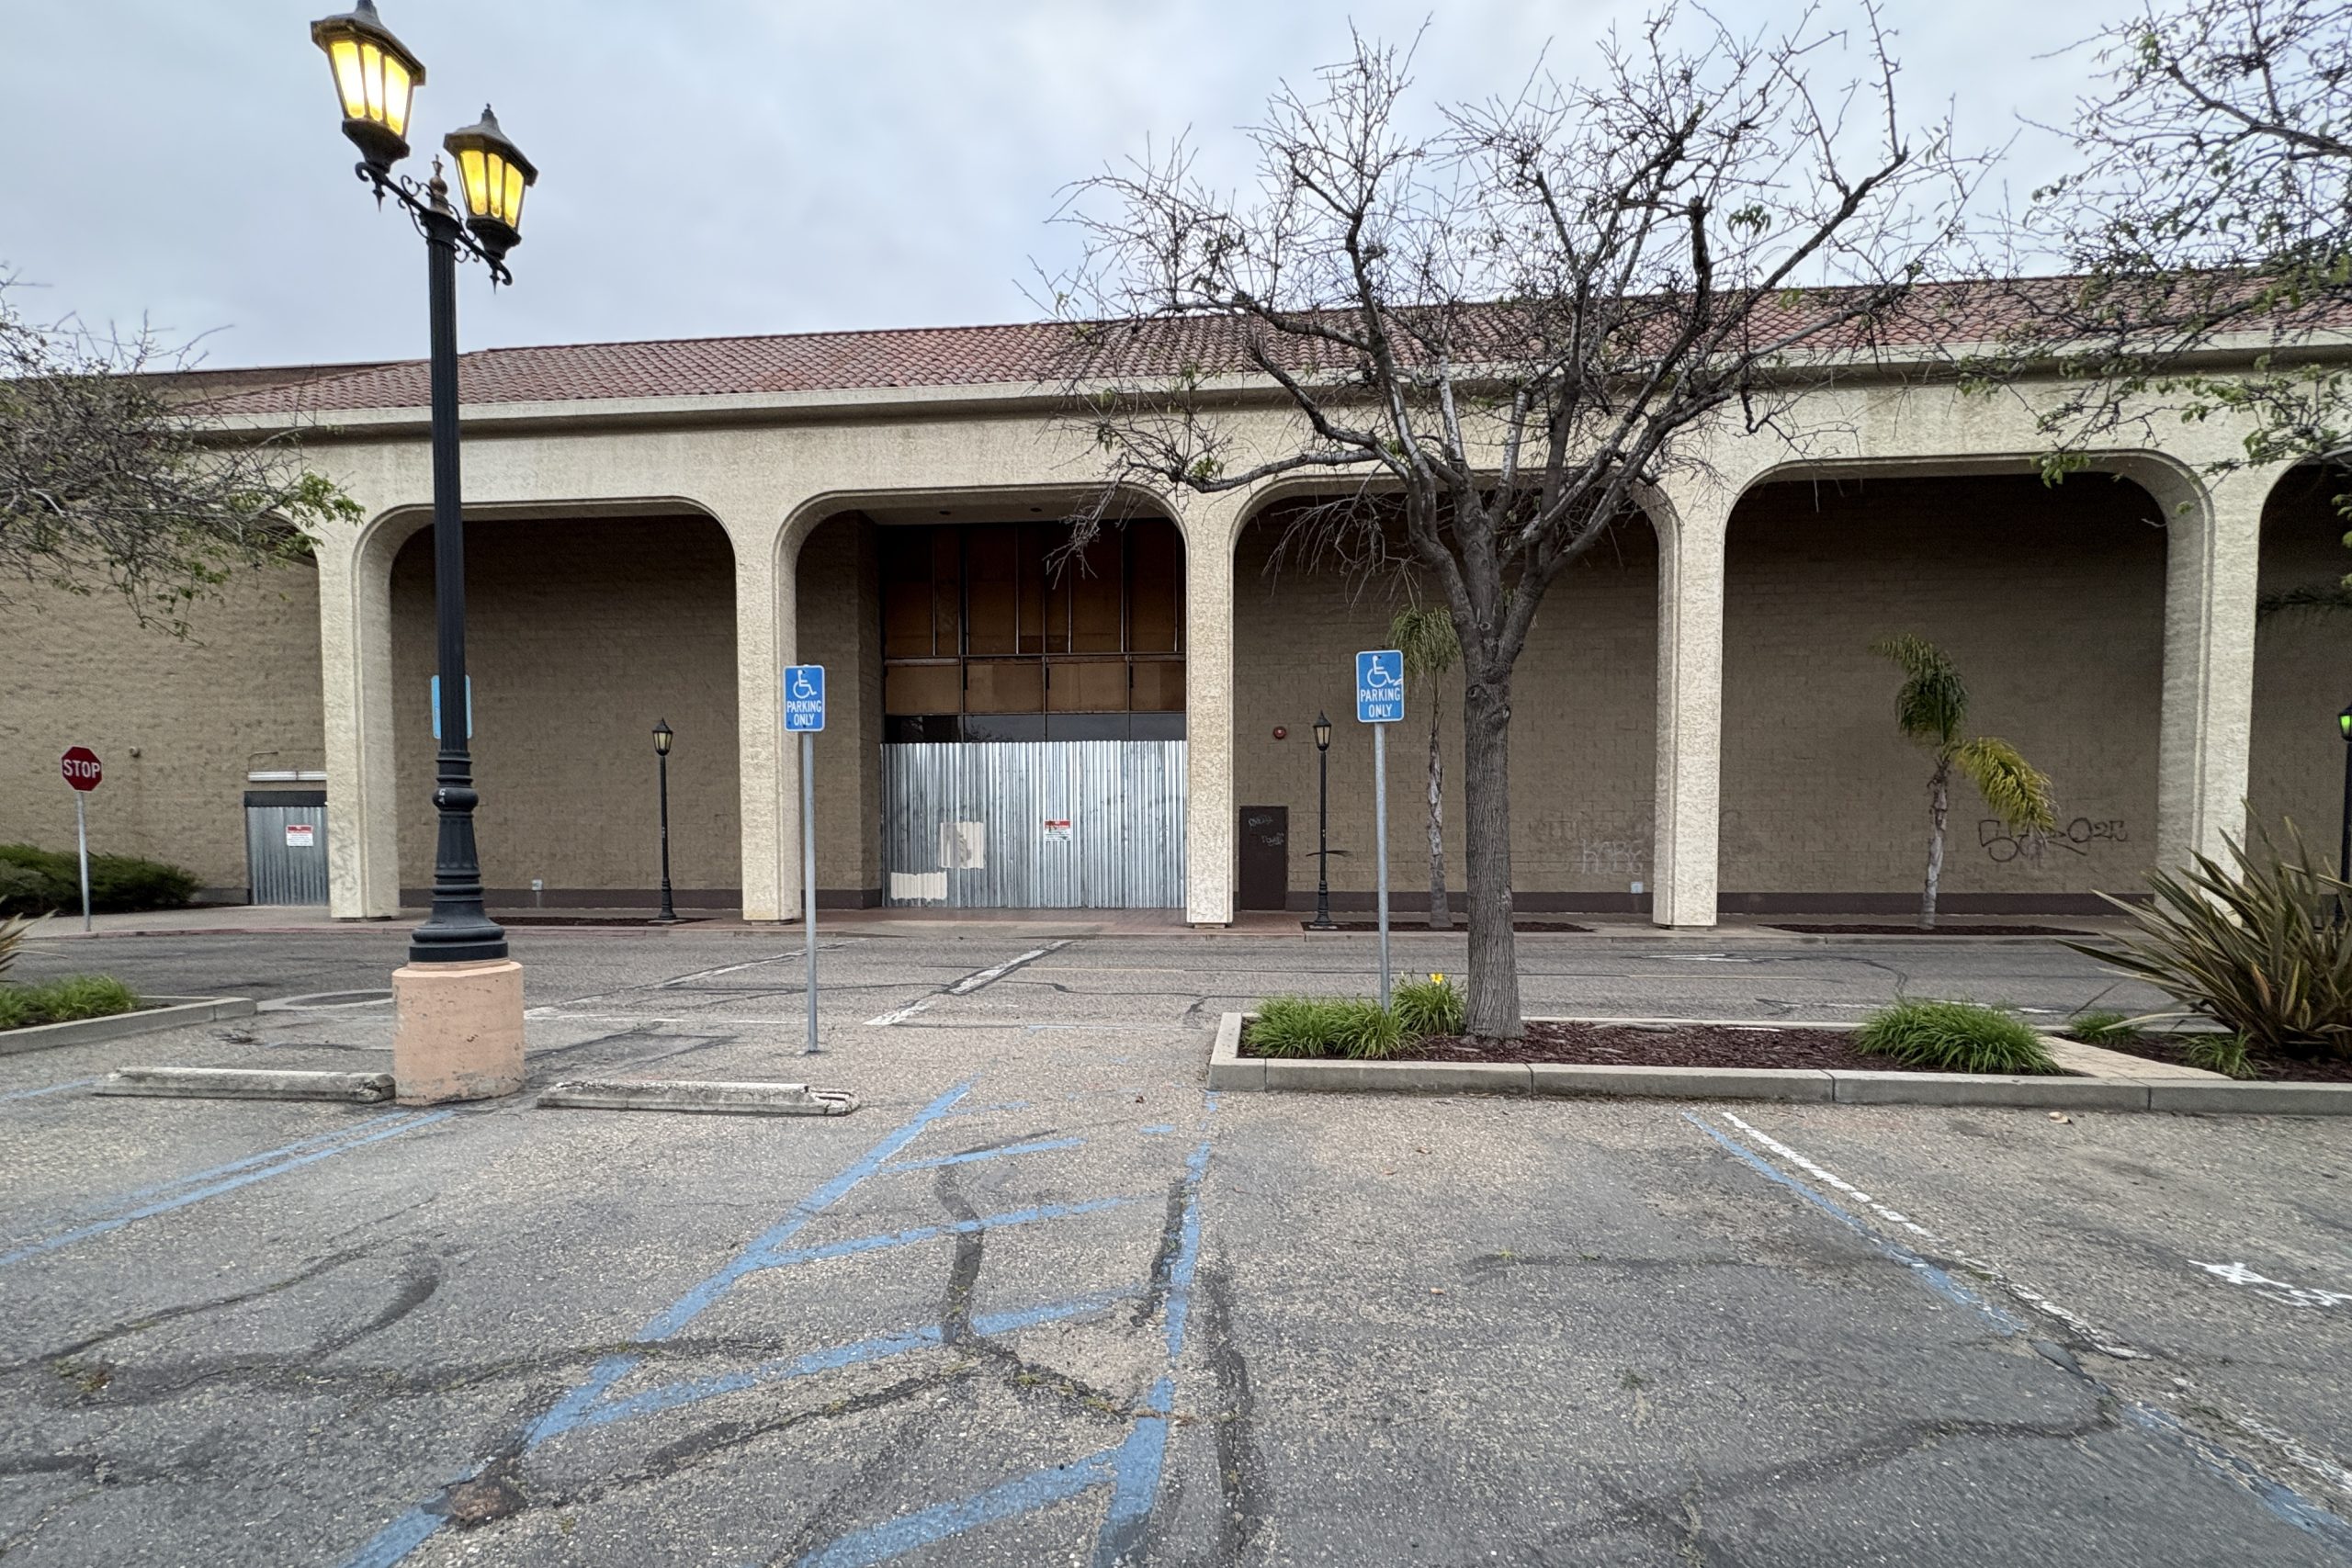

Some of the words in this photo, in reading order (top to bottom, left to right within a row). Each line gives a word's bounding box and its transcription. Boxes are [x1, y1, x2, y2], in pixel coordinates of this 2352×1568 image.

[1360, 688, 1401, 702] PARKING
[786, 700, 822, 713] PARKING
[1368, 704, 1393, 717] ONLY
[793, 713, 815, 726] ONLY
[63, 759, 101, 778] STOP
